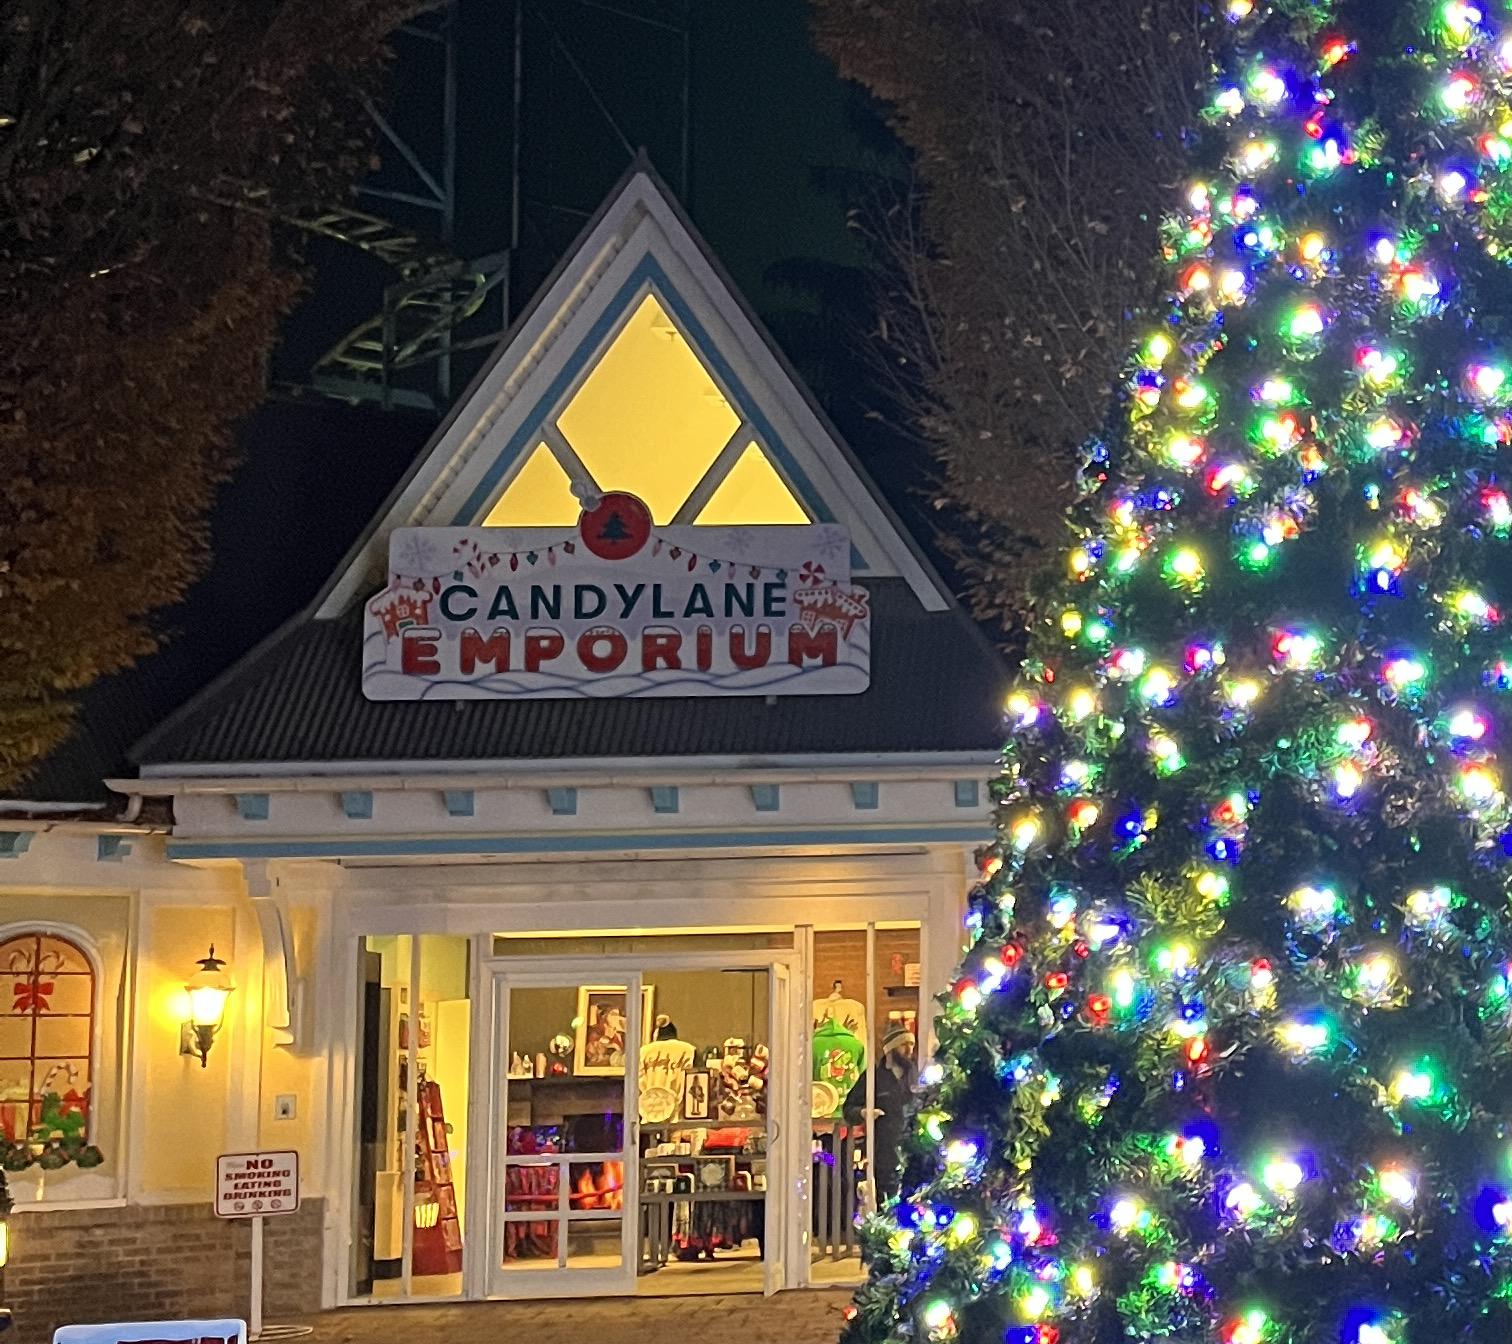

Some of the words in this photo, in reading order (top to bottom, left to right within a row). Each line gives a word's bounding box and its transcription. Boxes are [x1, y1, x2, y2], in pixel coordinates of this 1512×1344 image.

[438, 582, 788, 622] CANDYLANE
[401, 624, 839, 675] EMPORIUM
[246, 1159, 273, 1170] NO
[225, 1170, 290, 1181] SMOKING
[234, 1180, 281, 1190] EATING
[223, 1189, 292, 1200] DRINKING
